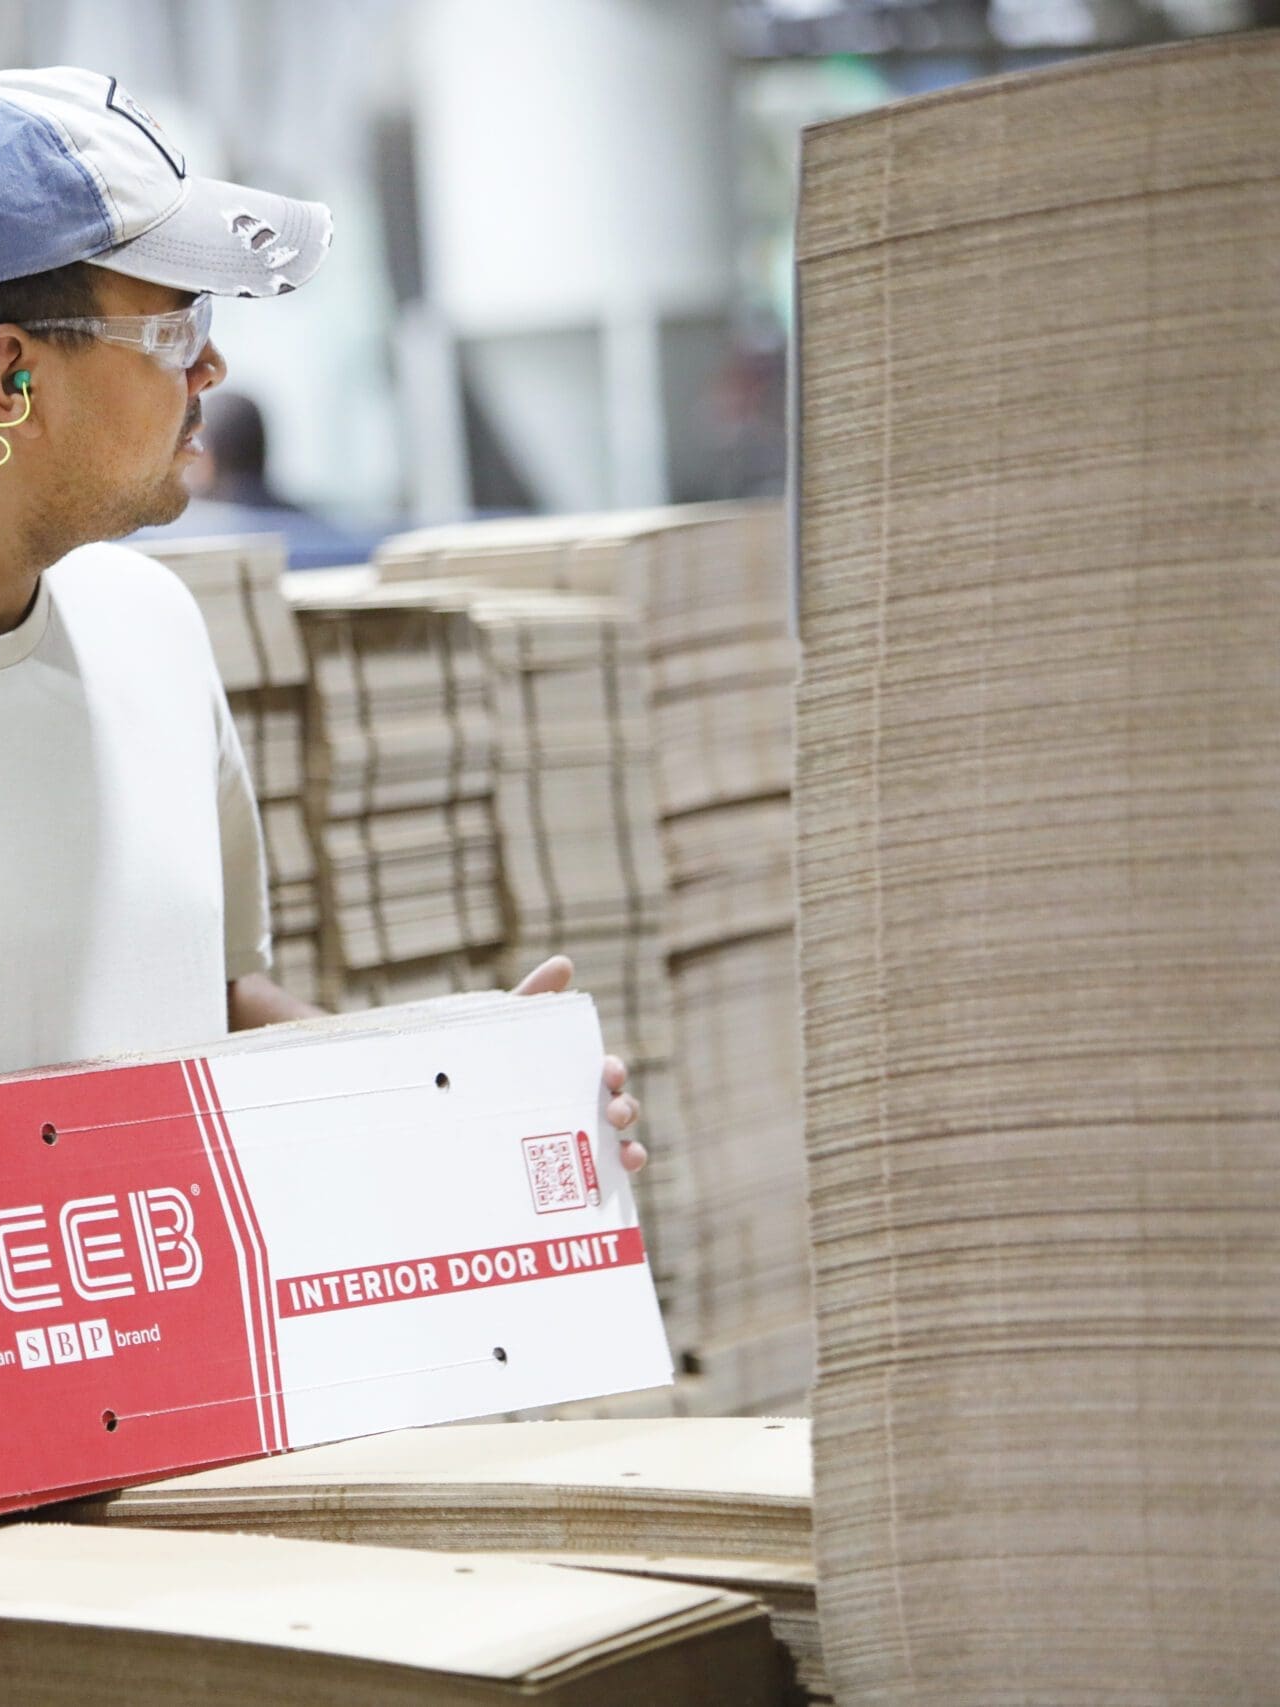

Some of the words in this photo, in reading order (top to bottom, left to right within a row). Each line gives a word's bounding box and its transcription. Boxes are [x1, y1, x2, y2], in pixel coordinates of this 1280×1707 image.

[289, 1262, 439, 1310] INTERIOR
[448, 1247, 537, 1287] DOOR
[546, 1234, 619, 1271] UNIT
[23, 1324, 106, 1364] SBP
[115, 1324, 161, 1347] brand
